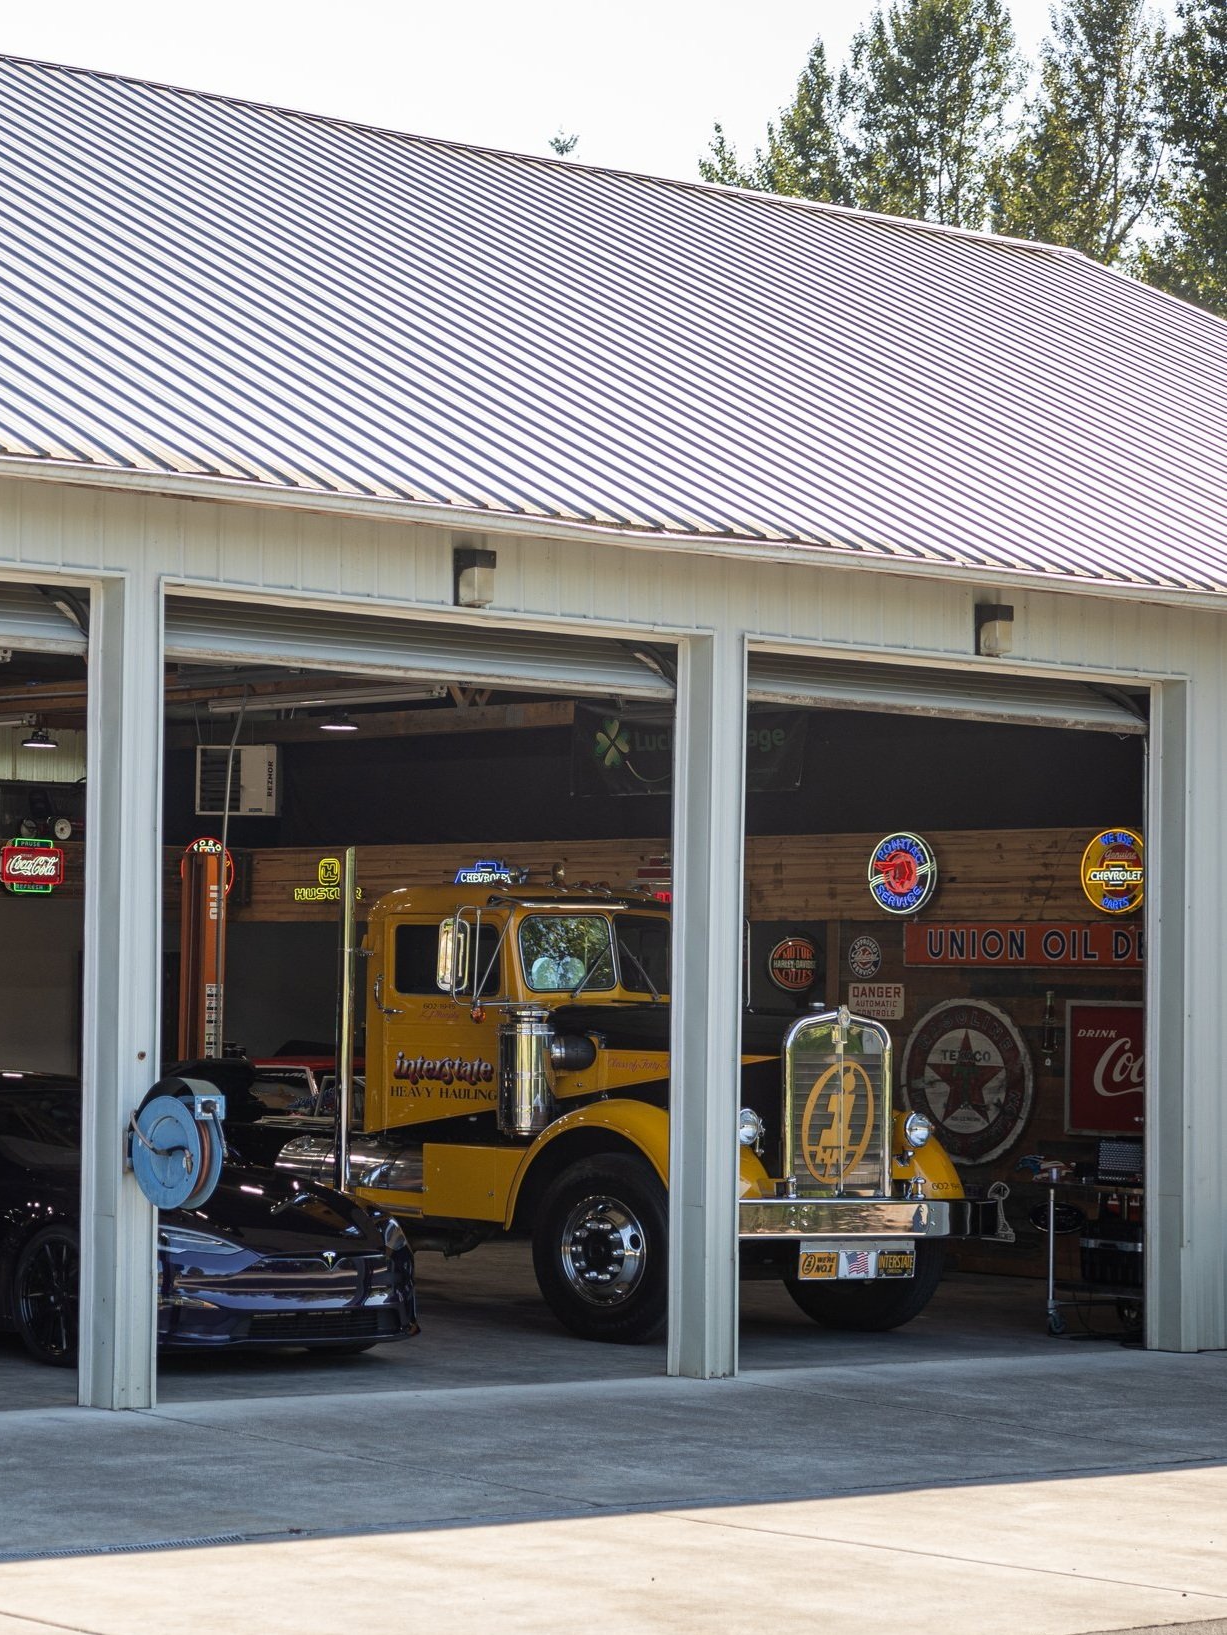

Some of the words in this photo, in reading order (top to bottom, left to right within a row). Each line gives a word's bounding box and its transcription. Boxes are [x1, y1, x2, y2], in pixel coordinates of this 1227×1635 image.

[266, 761, 274, 797] REZNOR
[1099, 832, 1115, 846] WE
[1116, 832, 1134, 847] USE
[877, 838, 925, 864] PONTIAC
[1104, 850, 1137, 861] Genuine
[1090, 870, 1143, 881] CHEVROLET
[876, 885, 924, 907] SERVICE
[1101, 897, 1130, 910] PARTS
[927, 928, 1027, 961] UNION
[1042, 928, 1099, 961] OIL
[781, 945, 813, 959] MOTOR
[782, 969, 813, 983] CYCLES
[852, 962, 876, 976] SERVICE
[852, 986, 901, 998] DANGER
[855, 1000, 898, 1008] AUTOMATIC
[857, 1009, 895, 1017] CONTROLS
[1077, 1029, 1117, 1039] DRINK
[941, 1049, 991, 1062] TEXACO
[393, 1051, 494, 1086] interstate
[390, 1085, 433, 1098] HEAVY
[439, 1087, 497, 1101] HAULING
[817, 1256, 835, 1264] WE'RE
[879, 1255, 914, 1269] INTERSTATE
